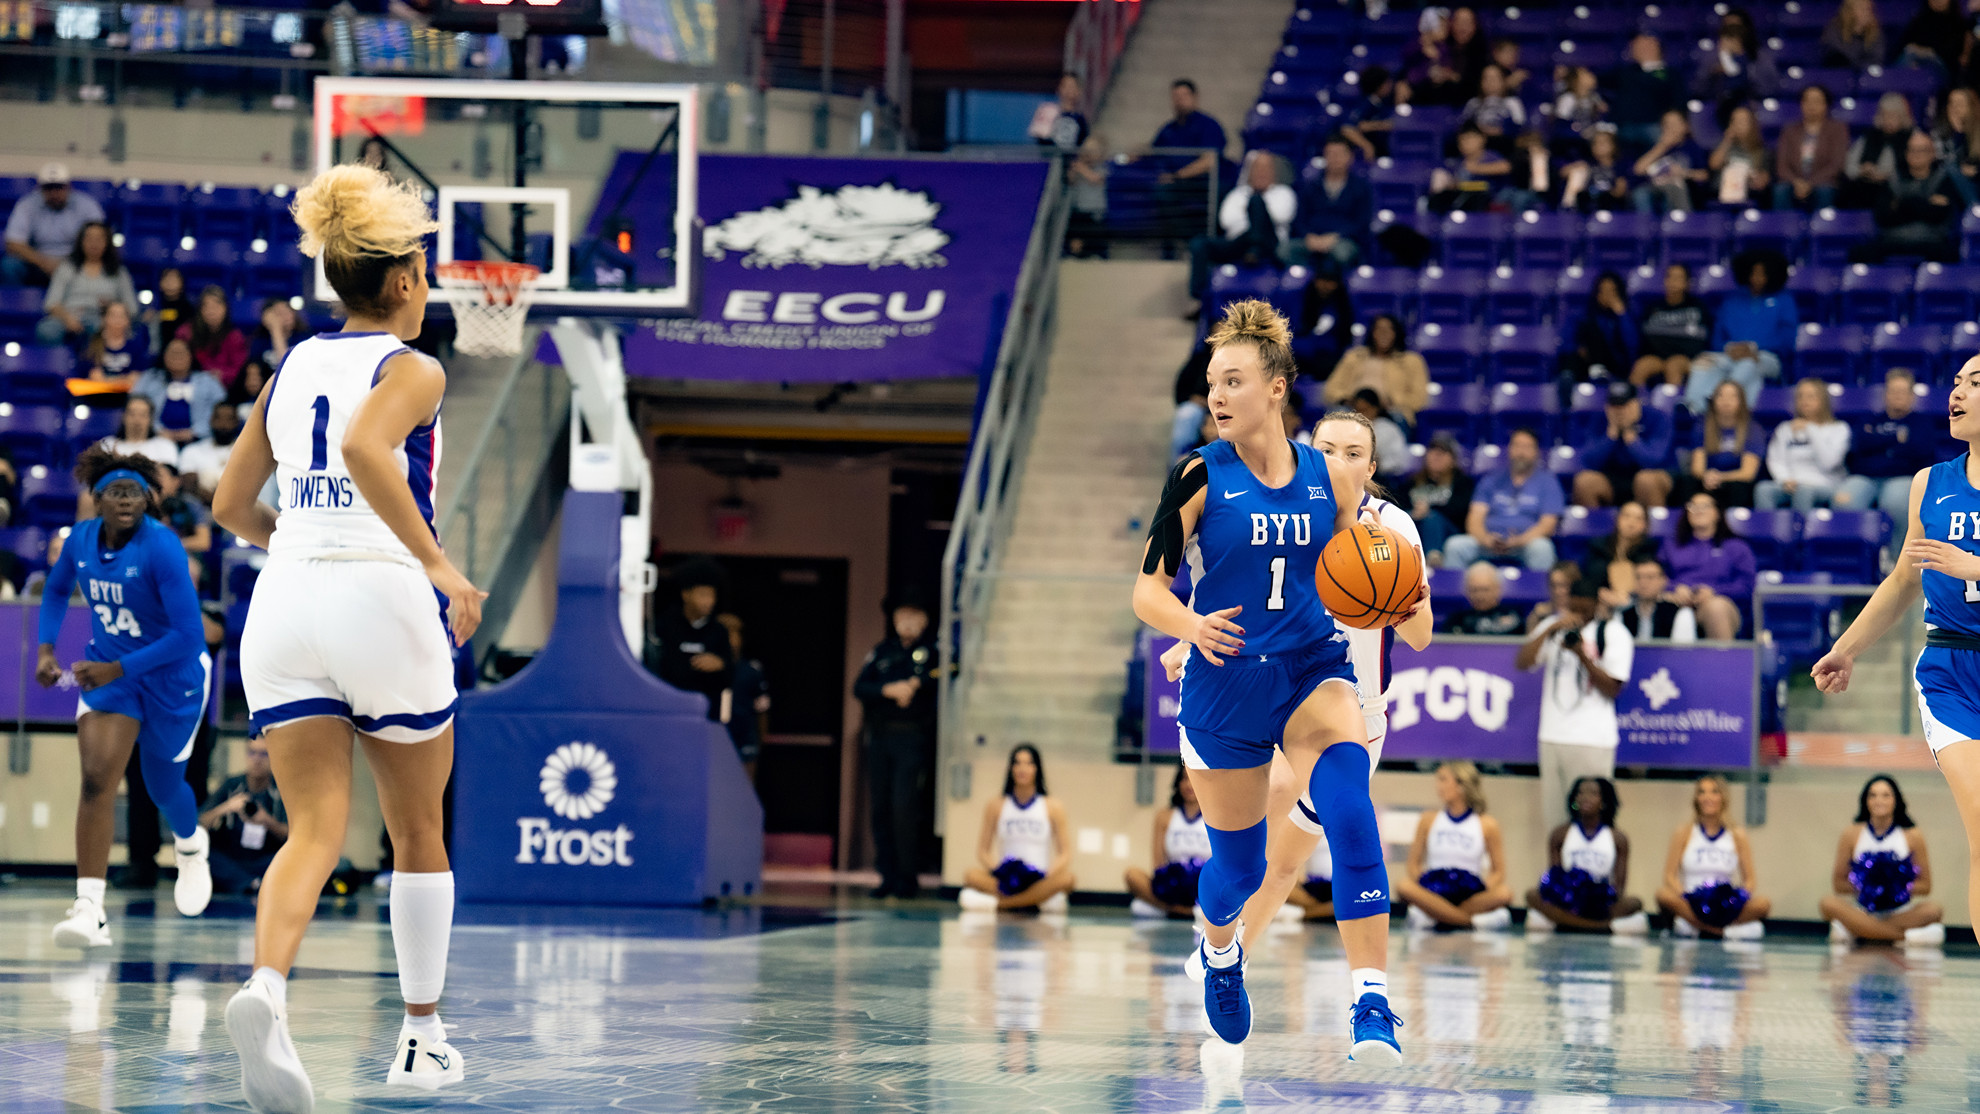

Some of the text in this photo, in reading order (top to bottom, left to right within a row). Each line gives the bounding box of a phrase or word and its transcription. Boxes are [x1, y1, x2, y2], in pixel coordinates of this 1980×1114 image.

[722, 289, 947, 325] EECU
[308, 395, 330, 471] 1
[290, 476, 353, 509] OWENS
[1250, 513, 1311, 546] BYU
[1947, 511, 1980, 541] BY
[89, 578, 124, 605] BYU
[1266, 556, 1287, 611] 1
[94, 604, 142, 638] 24
[1388, 666, 1515, 733] TCU
[515, 817, 635, 867] Frost
